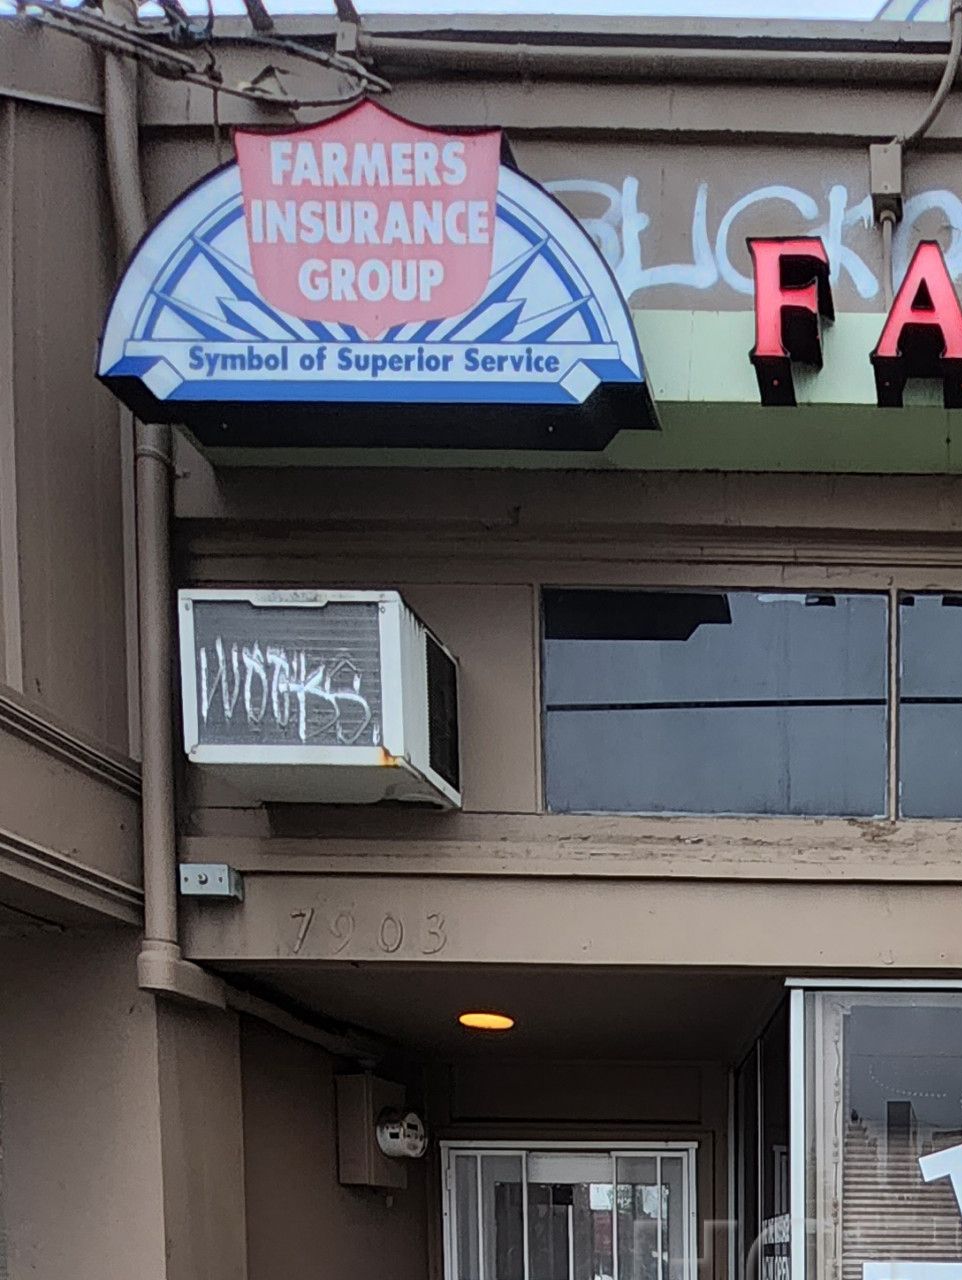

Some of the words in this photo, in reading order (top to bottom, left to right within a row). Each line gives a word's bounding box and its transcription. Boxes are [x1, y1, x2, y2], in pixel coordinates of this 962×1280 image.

[270, 141, 466, 187] FARMERS
[250, 200, 490, 246] INSURANCE
[297, 259, 445, 302] GROUP
[188, 345, 288, 377] Symbol
[300, 345, 328, 371] of
[336, 347, 455, 377] Superior
[463, 347, 561, 373] Service
[289, 907, 448, 956] 7903
